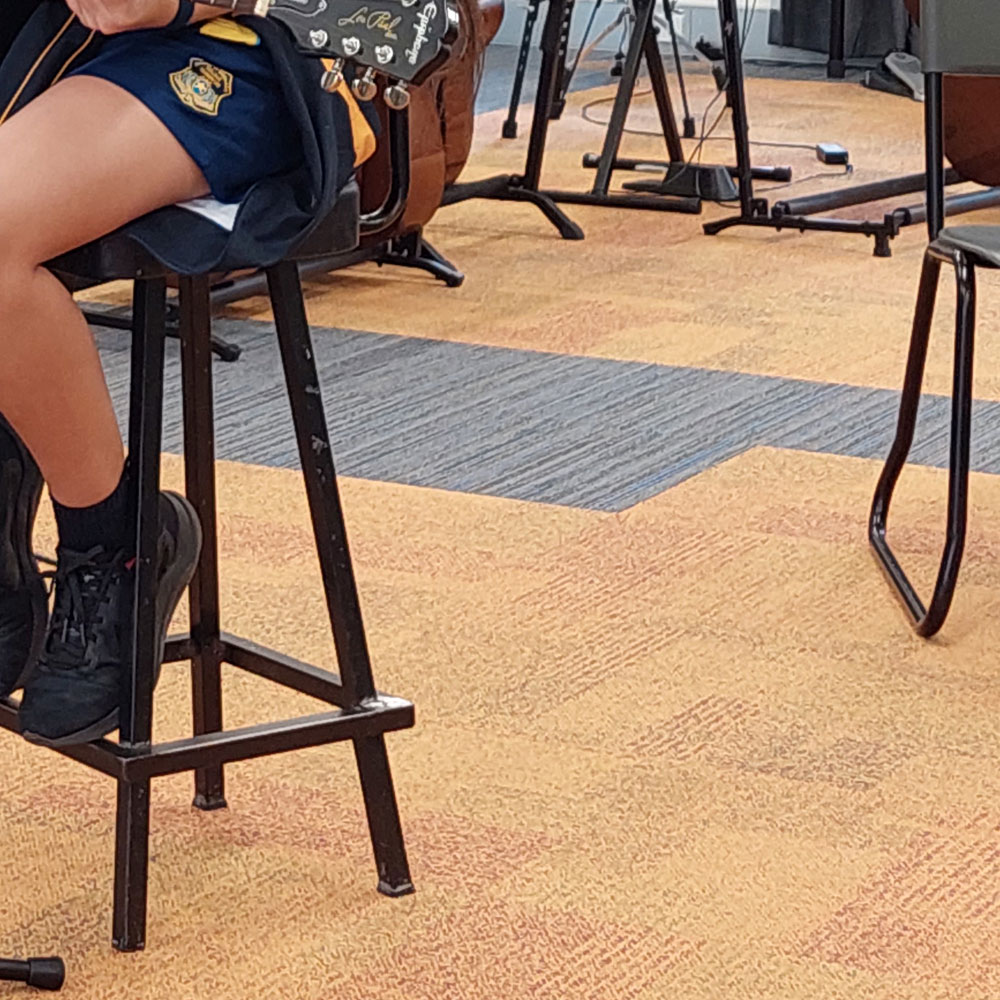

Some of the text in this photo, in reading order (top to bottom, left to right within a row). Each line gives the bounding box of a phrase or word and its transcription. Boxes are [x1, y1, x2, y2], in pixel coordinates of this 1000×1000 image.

[338, 6, 402, 32] Les Paul
[405, 0, 437, 65] Epiphone
